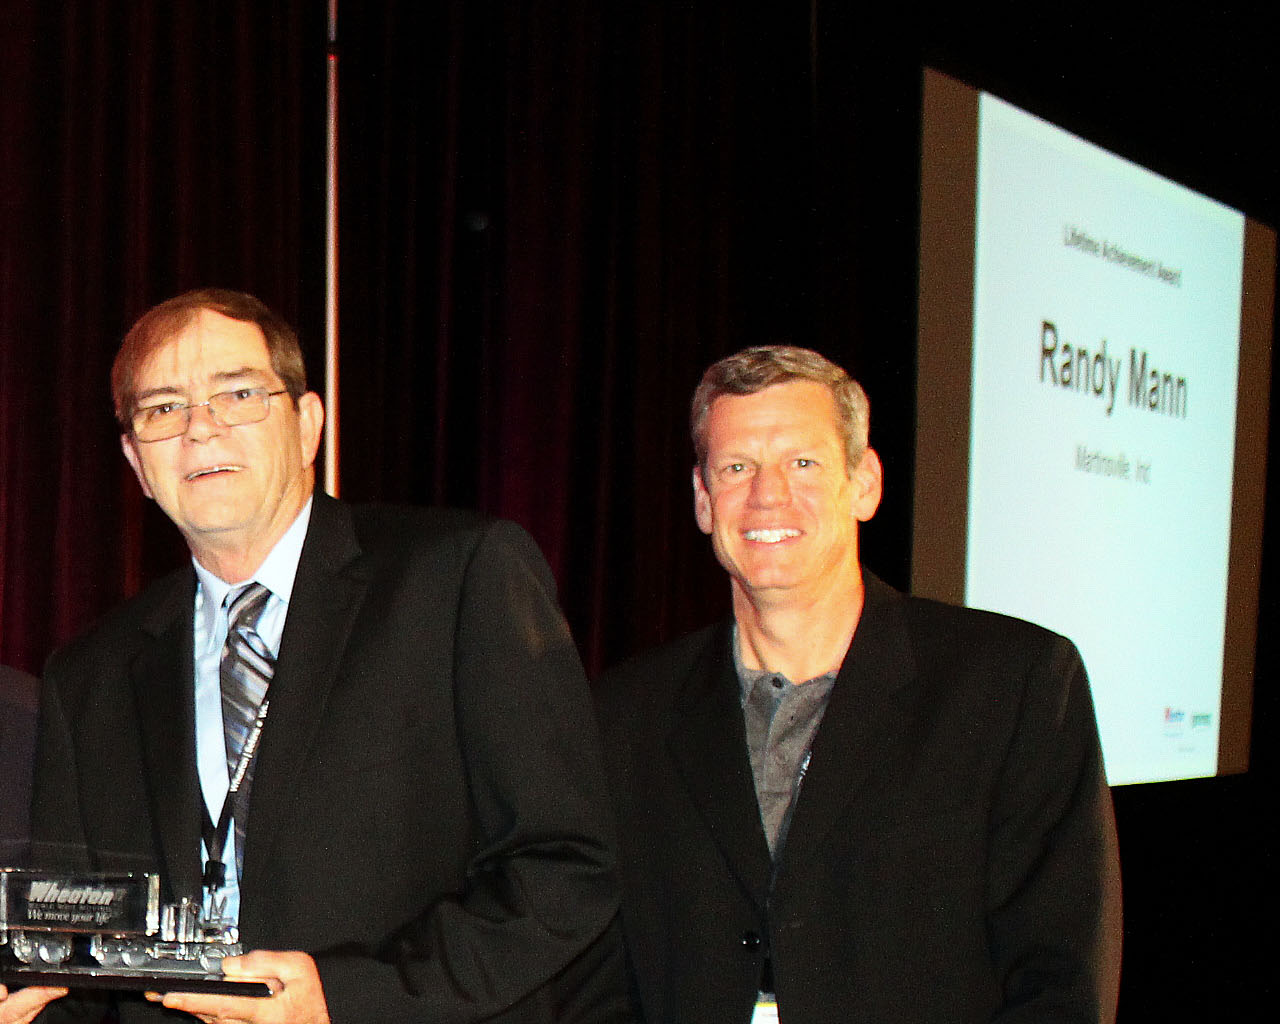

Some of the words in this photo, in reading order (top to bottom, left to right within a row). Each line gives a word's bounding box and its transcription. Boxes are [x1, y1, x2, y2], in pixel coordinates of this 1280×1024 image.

[1039, 319, 1121, 417] Randy
[1128, 345, 1188, 420] Mann
[29, 881, 116, 905] Wheaton
